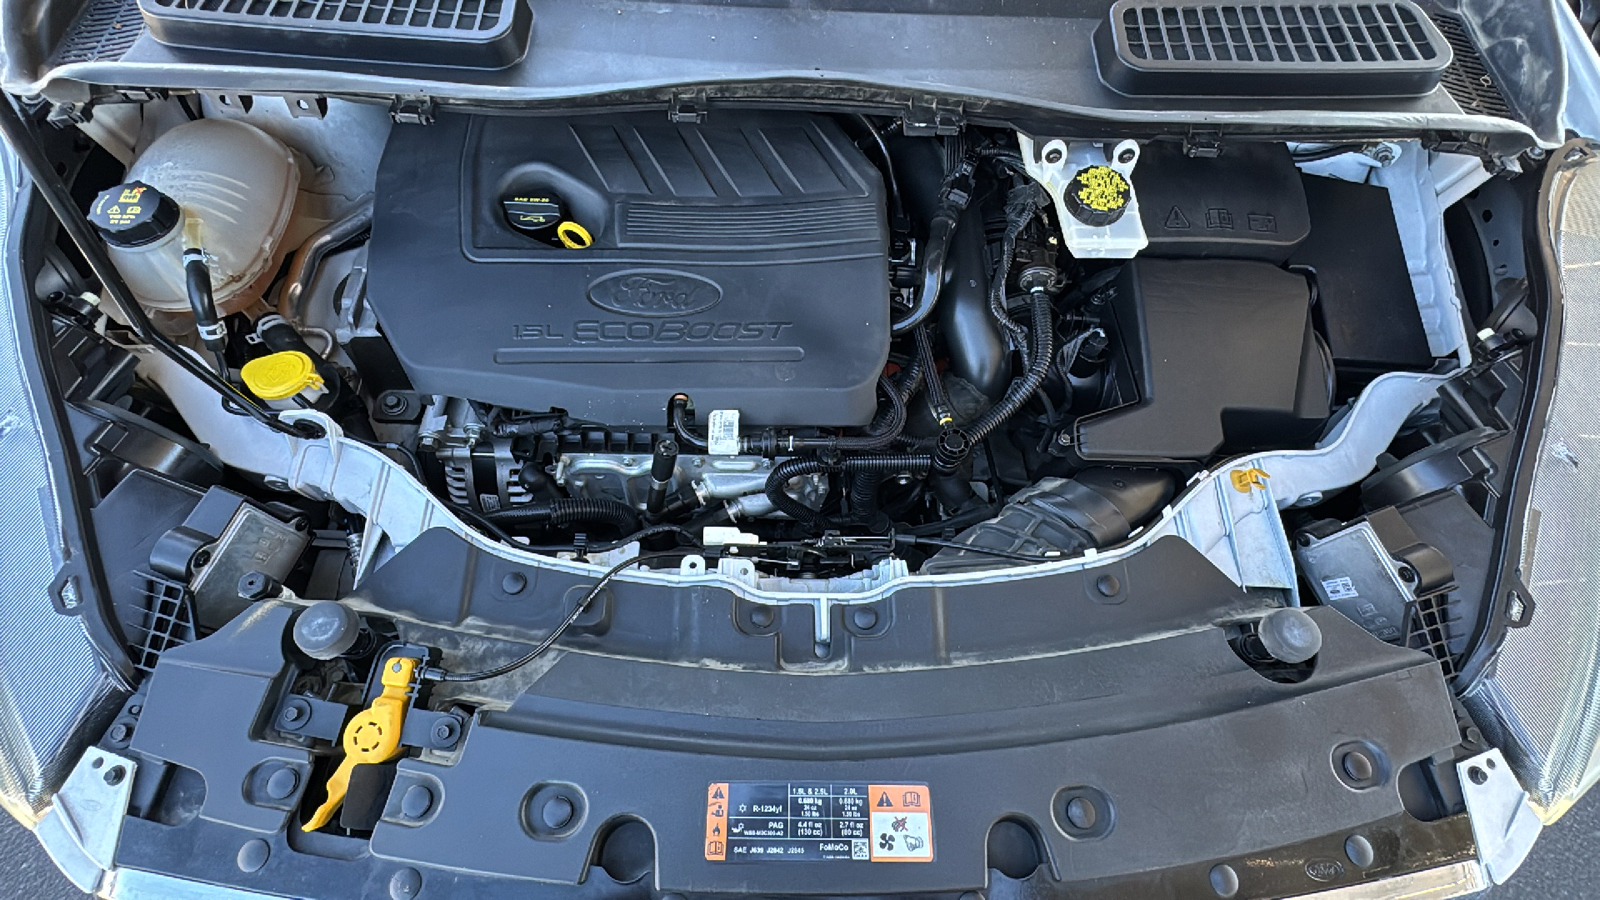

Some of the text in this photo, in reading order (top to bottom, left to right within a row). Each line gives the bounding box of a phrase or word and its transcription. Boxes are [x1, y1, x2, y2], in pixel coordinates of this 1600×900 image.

[610, 276, 698, 309] Ford
[753, 805, 782, 813] R-1234yf
[820, 843, 849, 851] FoMoCo
